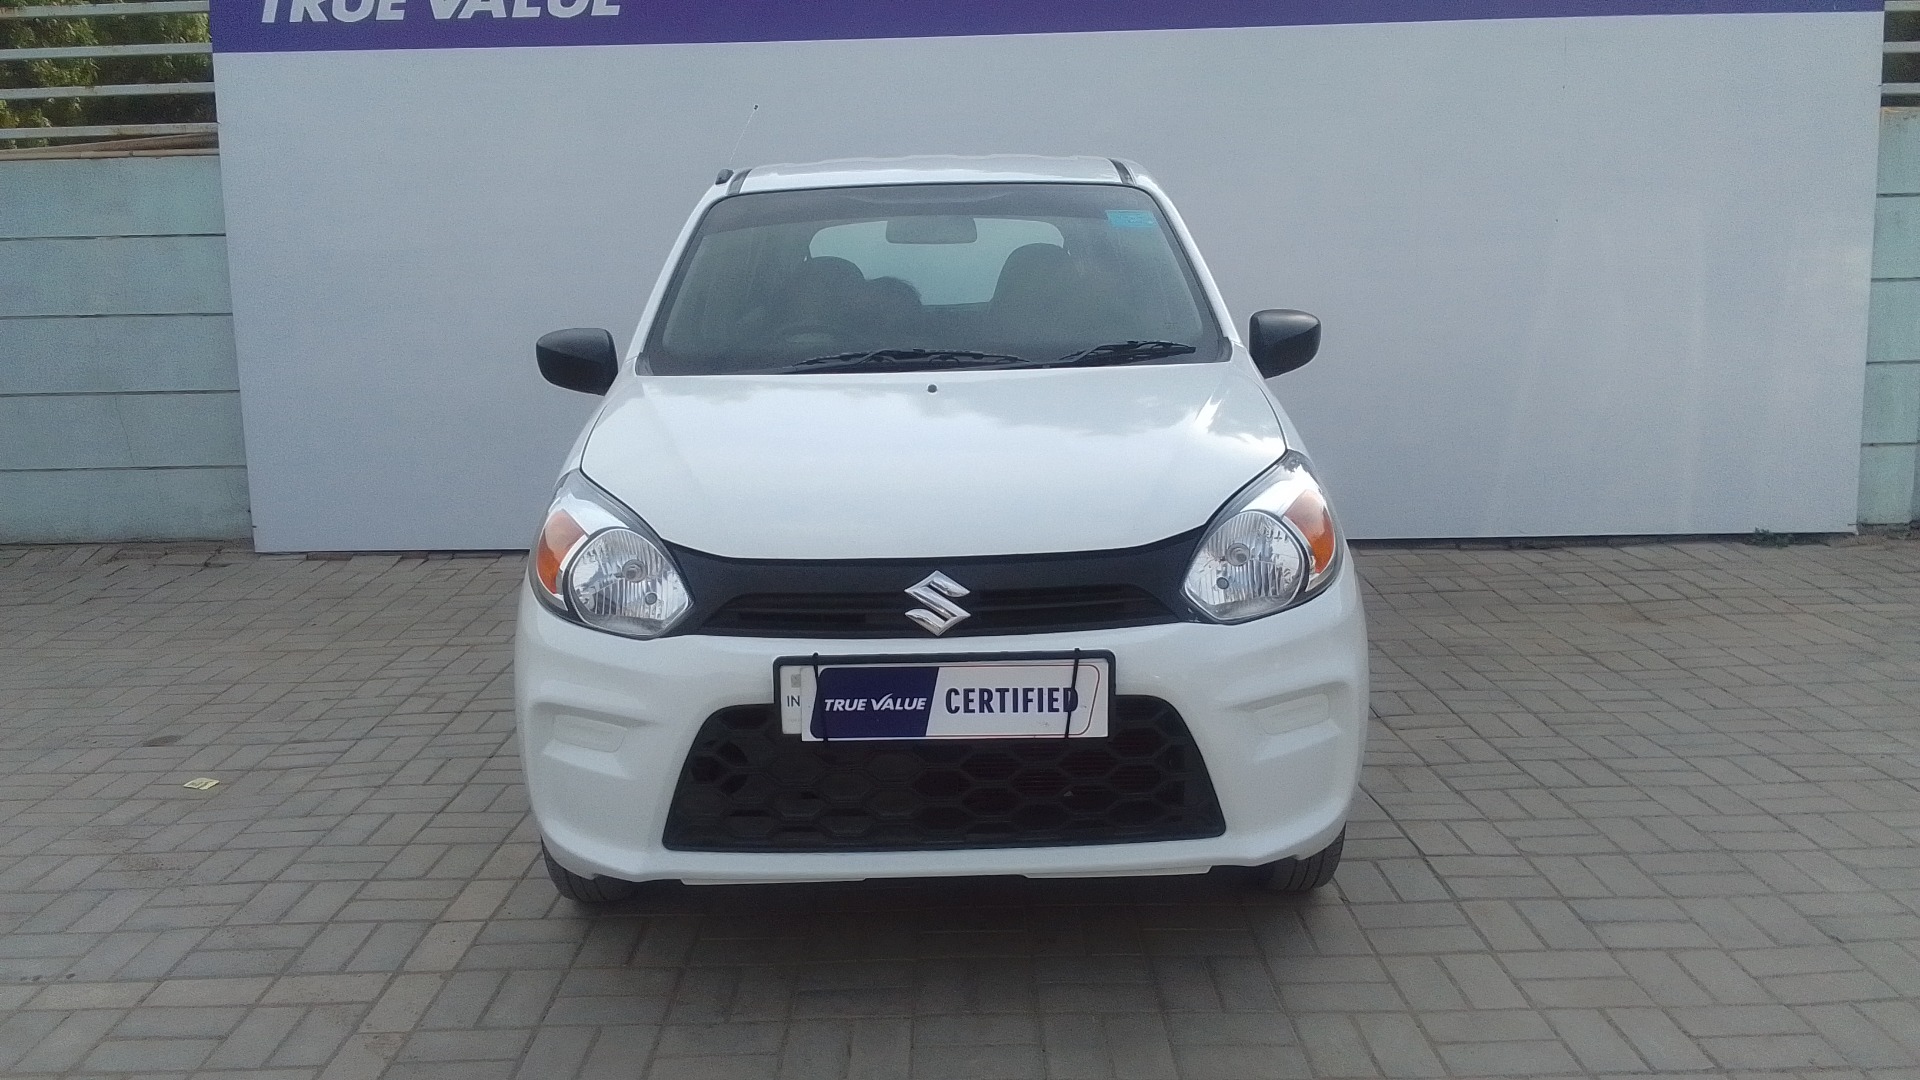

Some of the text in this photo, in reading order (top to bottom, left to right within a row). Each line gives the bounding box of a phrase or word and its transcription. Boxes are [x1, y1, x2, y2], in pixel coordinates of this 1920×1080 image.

[824, 692, 928, 712] TRUE VALUE
[945, 687, 1079, 714] CERTIFIED
